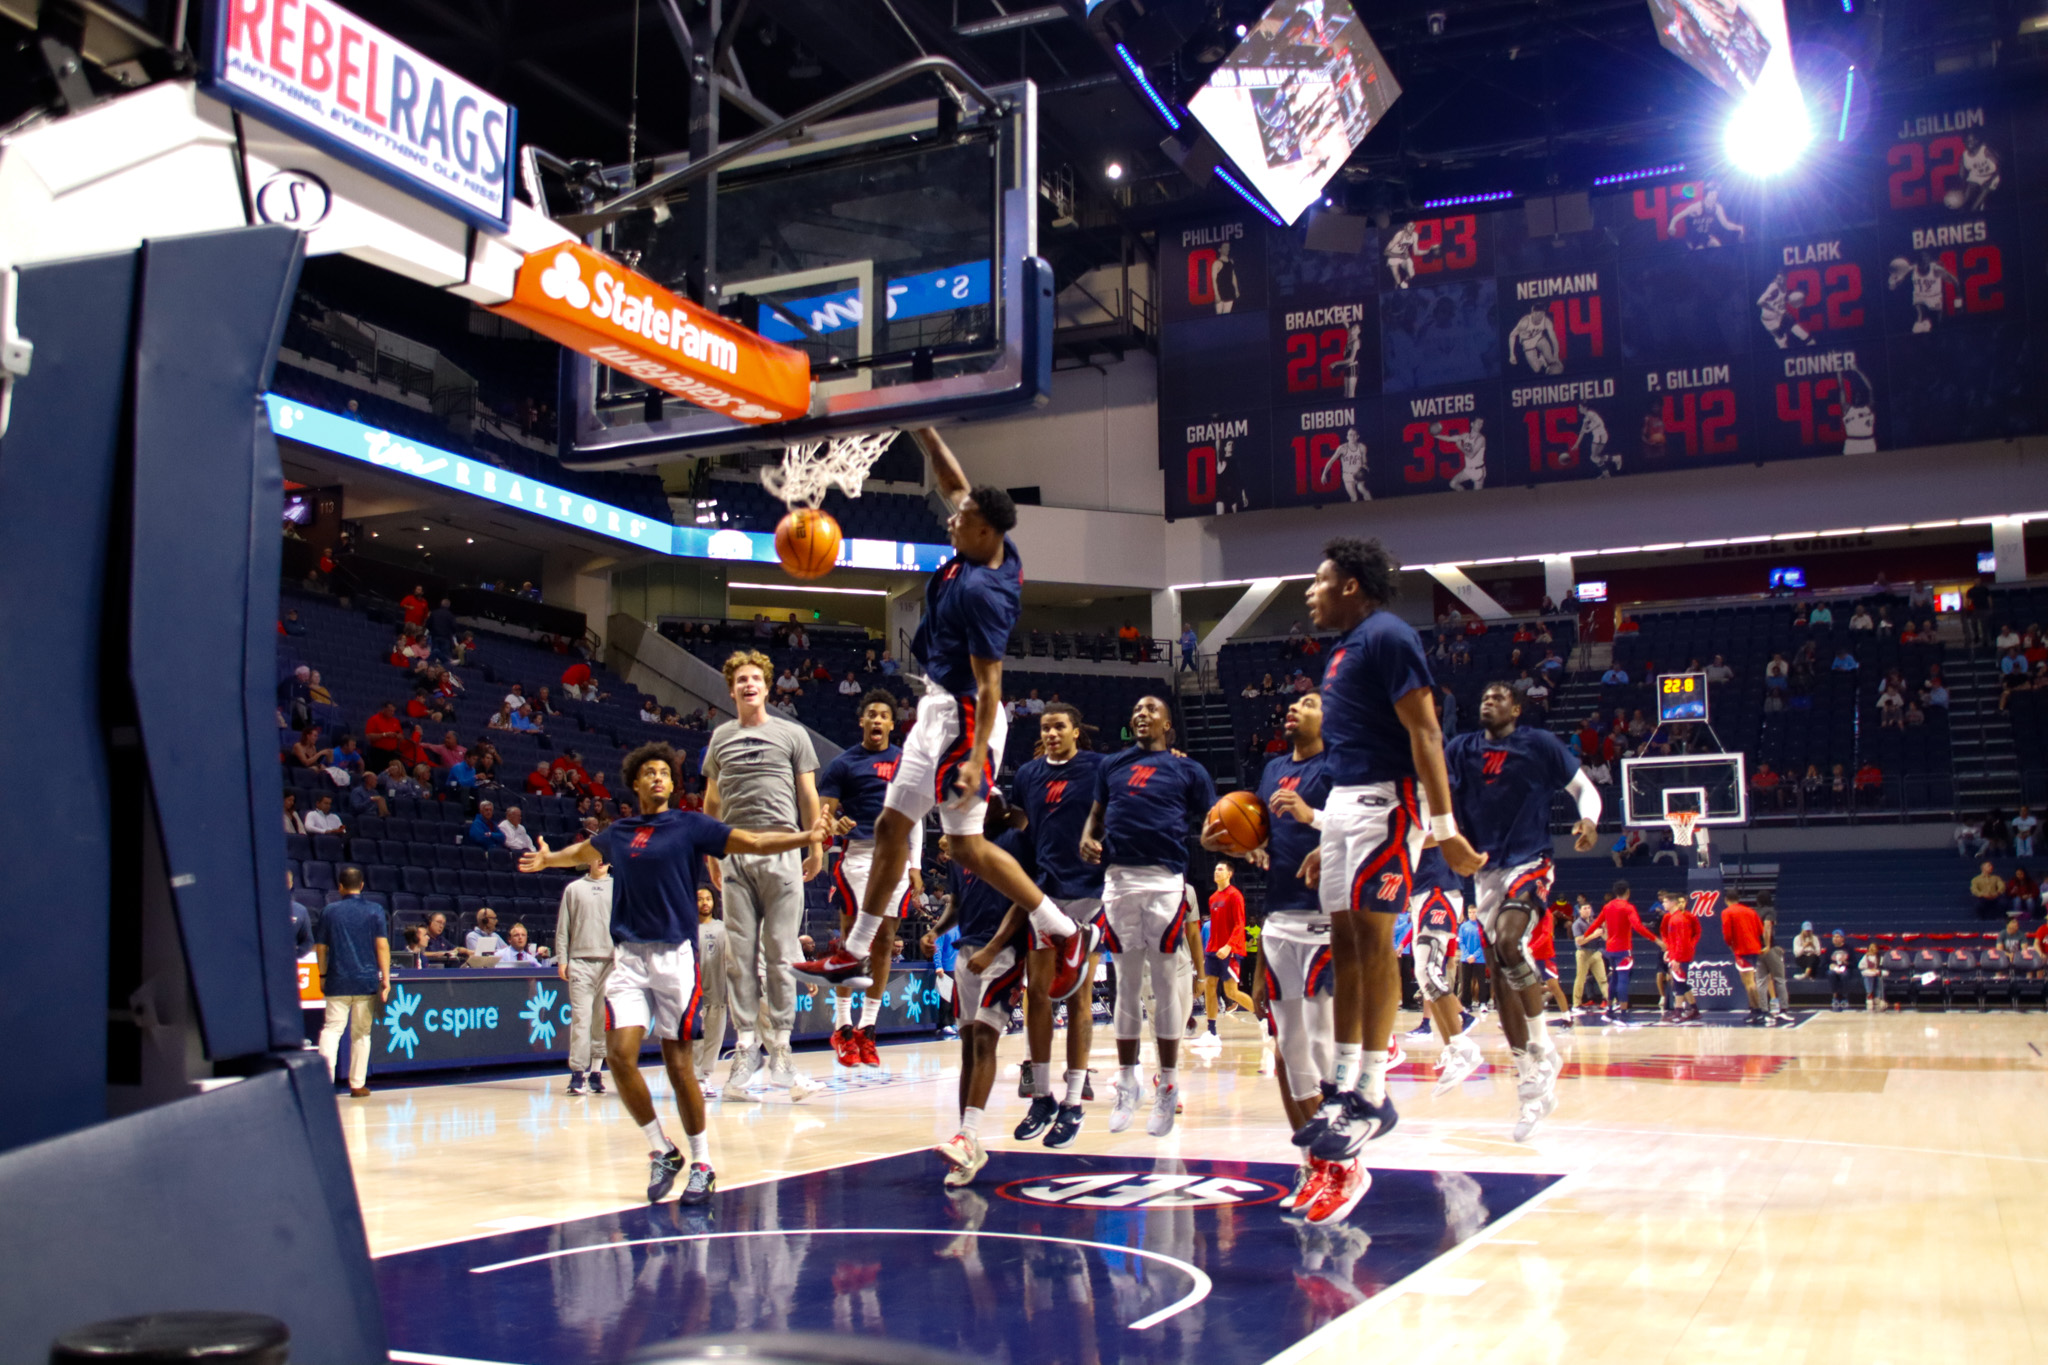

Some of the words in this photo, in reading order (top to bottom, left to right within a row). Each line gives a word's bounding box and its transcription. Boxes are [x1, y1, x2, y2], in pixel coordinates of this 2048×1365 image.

[433, 160, 461, 183] OLE
[1887, 136, 1966, 210] 22
[1182, 222, 1244, 247] PHILLIPS
[1912, 222, 1986, 250] BARNES
[1783, 241, 1841, 266] CLARK
[1516, 272, 1598, 301] NEUMANN
[1940, 246, 2004, 315] 12
[1785, 263, 1864, 333] 22
[1549, 294, 1604, 360] 14
[1287, 328, 1350, 394] 22
[1785, 352, 1856, 378] CONNER
[1667, 365, 1730, 387] GILLOM
[1411, 394, 1475, 418] WATERS
[1512, 378, 1615, 408] SPRINGFIELD
[1301, 408, 1355, 431] GIBBON
[1661, 389, 1738, 456] 42
[1776, 379, 1852, 447] 43
[1187, 419, 1248, 444] GRAHAM
[1523, 406, 1581, 473] 15
[1686, 979, 1728, 988] RIVER
[1687, 970, 1726, 979] PEARL
[1691, 987, 1733, 996] ESORT
